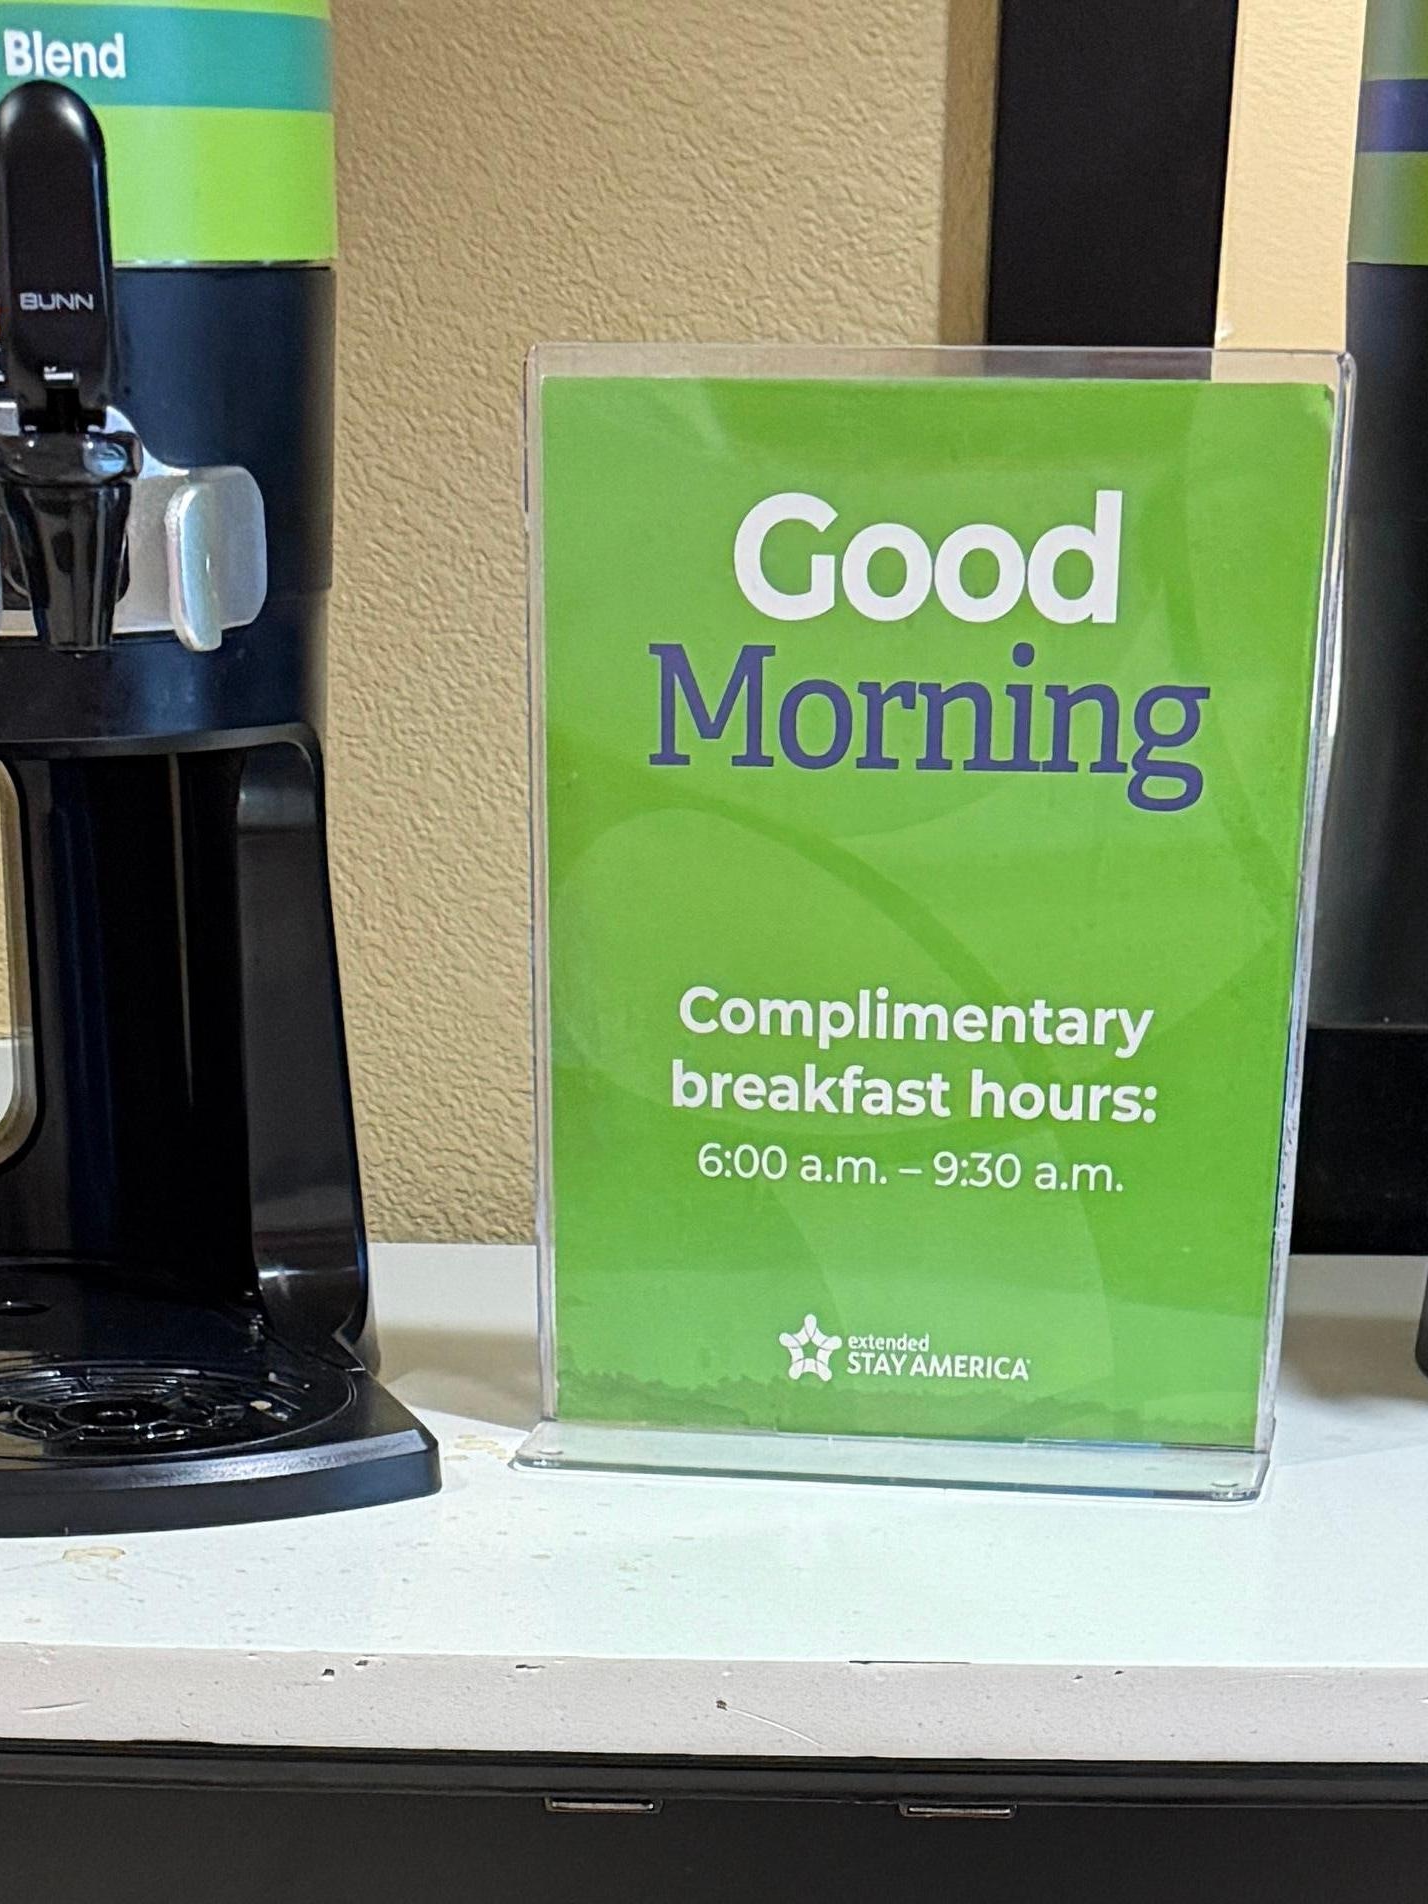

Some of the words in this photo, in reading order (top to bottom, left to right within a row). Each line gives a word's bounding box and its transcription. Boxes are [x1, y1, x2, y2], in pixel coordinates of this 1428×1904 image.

[4, 29, 126, 78] Blend
[20, 292, 94, 311] BUNN
[734, 490, 1123, 624] Good
[649, 642, 1210, 812] Morning
[679, 986, 1153, 1058] Complimentary
[672, 1059, 951, 1117] breakfast
[970, 1069, 1158, 1123] hours:
[698, 1143, 787, 1178] 6:00
[800, 1153, 888, 1185] a.m.
[933, 1152, 1021, 1188] 9:30
[1035, 1160, 1124, 1192] a.m.
[847, 1352, 906, 1376] STAY
[909, 1355, 1029, 1381] AMERICA
[848, 1333, 930, 1352] extended
